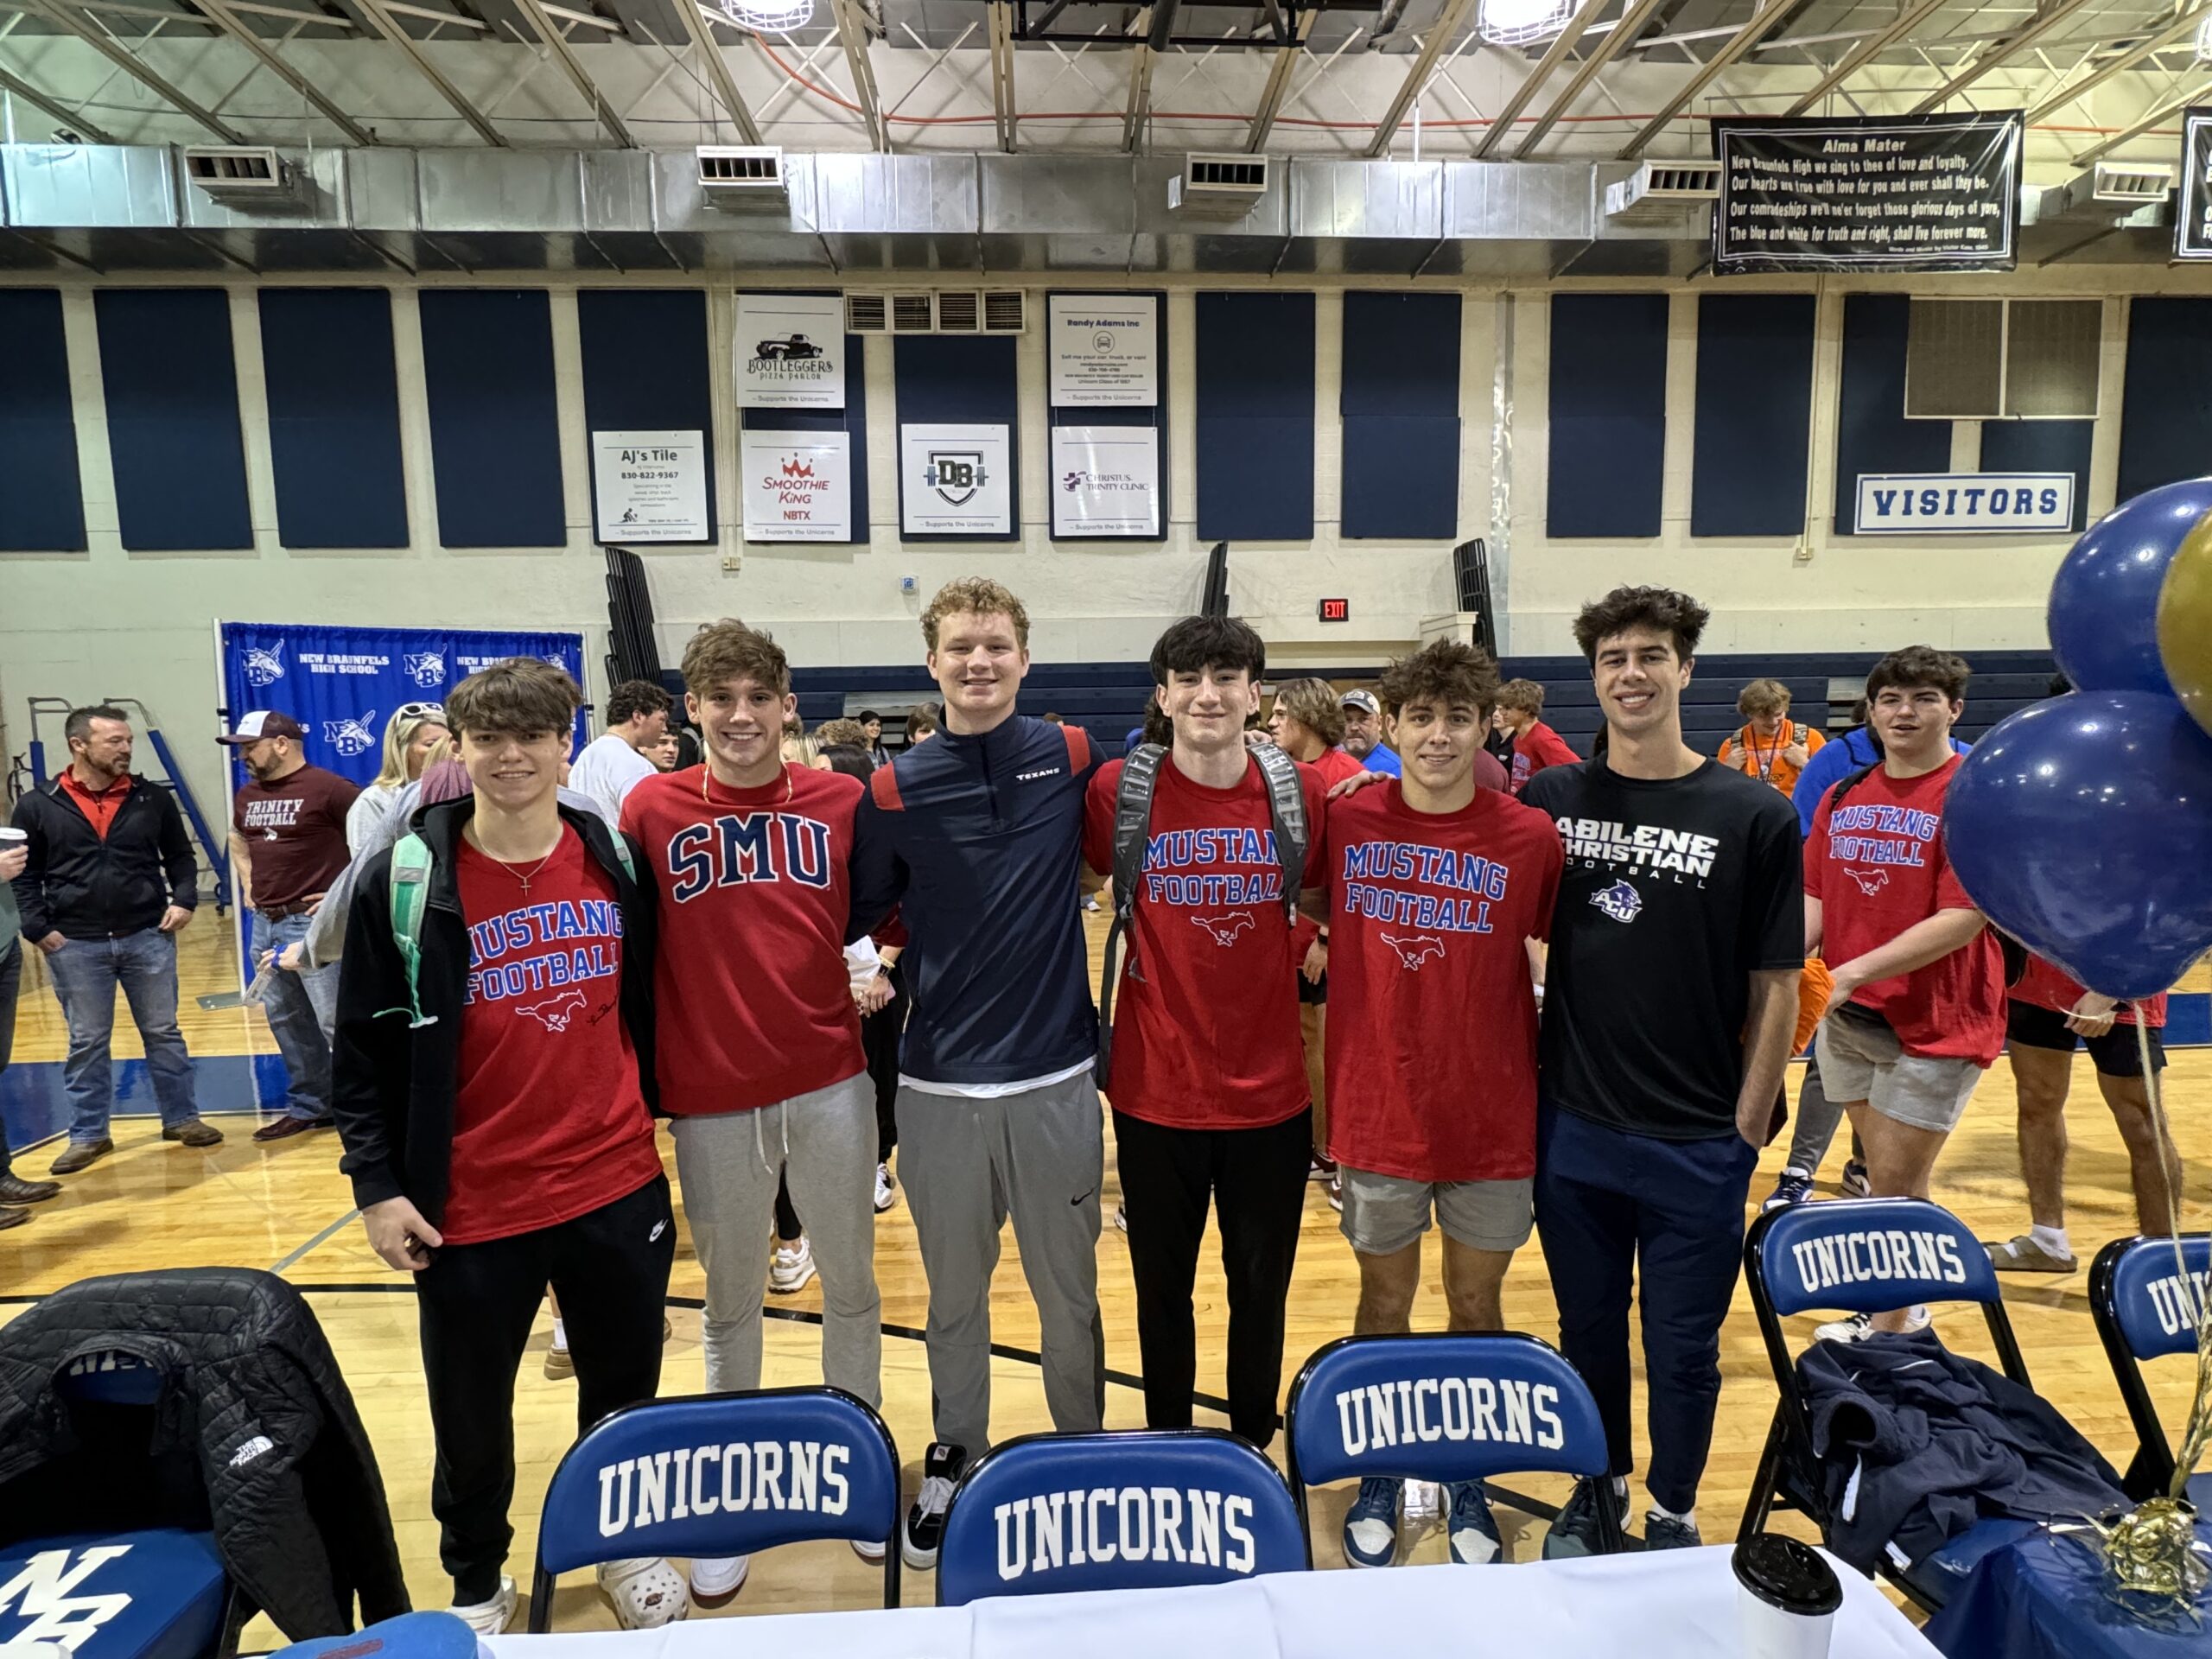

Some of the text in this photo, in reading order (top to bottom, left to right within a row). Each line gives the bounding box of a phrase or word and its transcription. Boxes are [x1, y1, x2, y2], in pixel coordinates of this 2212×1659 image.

[1822, 138, 1906, 153] Alma Mater
[1732, 154, 1969, 176] New Braunfels High we sing to thee of love and loyalty.
[1732, 175, 1989, 195] Our hearts are true with love for you and ever shall they be.
[1730, 201, 1747, 217] Our
[1750, 201, 1807, 219] comradeships
[1810, 202, 1830, 216] we'll
[1832, 203, 1853, 216] ne'er
[1855, 202, 1881, 219] forget
[1884, 202, 1909, 216] those
[1910, 200, 1944, 219] glorious
[1945, 200, 1965, 219] days
[1967, 200, 1978, 215] of
[1730, 225, 1988, 244] The blue and white for truth and right, shall live forever more.
[1067, 320, 1094, 328] Randy
[747, 359, 834, 374] BOOTLEGGERS
[621, 449, 677, 465] AJ's Tile
[761, 476, 830, 491] SMOOTHIE
[938, 460, 973, 488] DB
[1873, 488, 2057, 516] VISITORS
[783, 511, 810, 520] NBTX
[1325, 601, 1345, 618] EXIT
[299, 654, 324, 664] NEW
[339, 664, 378, 674] SCHOOL
[1016, 767, 1060, 780] TEXANS
[246, 798, 304, 814] TRINITY
[245, 812, 297, 827] FOOTBALL
[1828, 804, 1939, 842] MUSTANG
[1555, 817, 1719, 861] ABILENE
[668, 812, 830, 903] SMU
[1141, 828, 1282, 872] MUSTAN
[1344, 842, 1508, 901] MUSTANG
[1566, 857, 1706, 889] OOTBALL
[1345, 882, 1493, 933] FOOTBALL
[1594, 892, 1635, 920] ACU
[1792, 1230, 1967, 1294] UNICORNS
[1336, 1377, 1564, 1457] UNICORNS
[599, 1440, 849, 1538] UNICORNS
[995, 1486, 1255, 1581] UNICORNS
